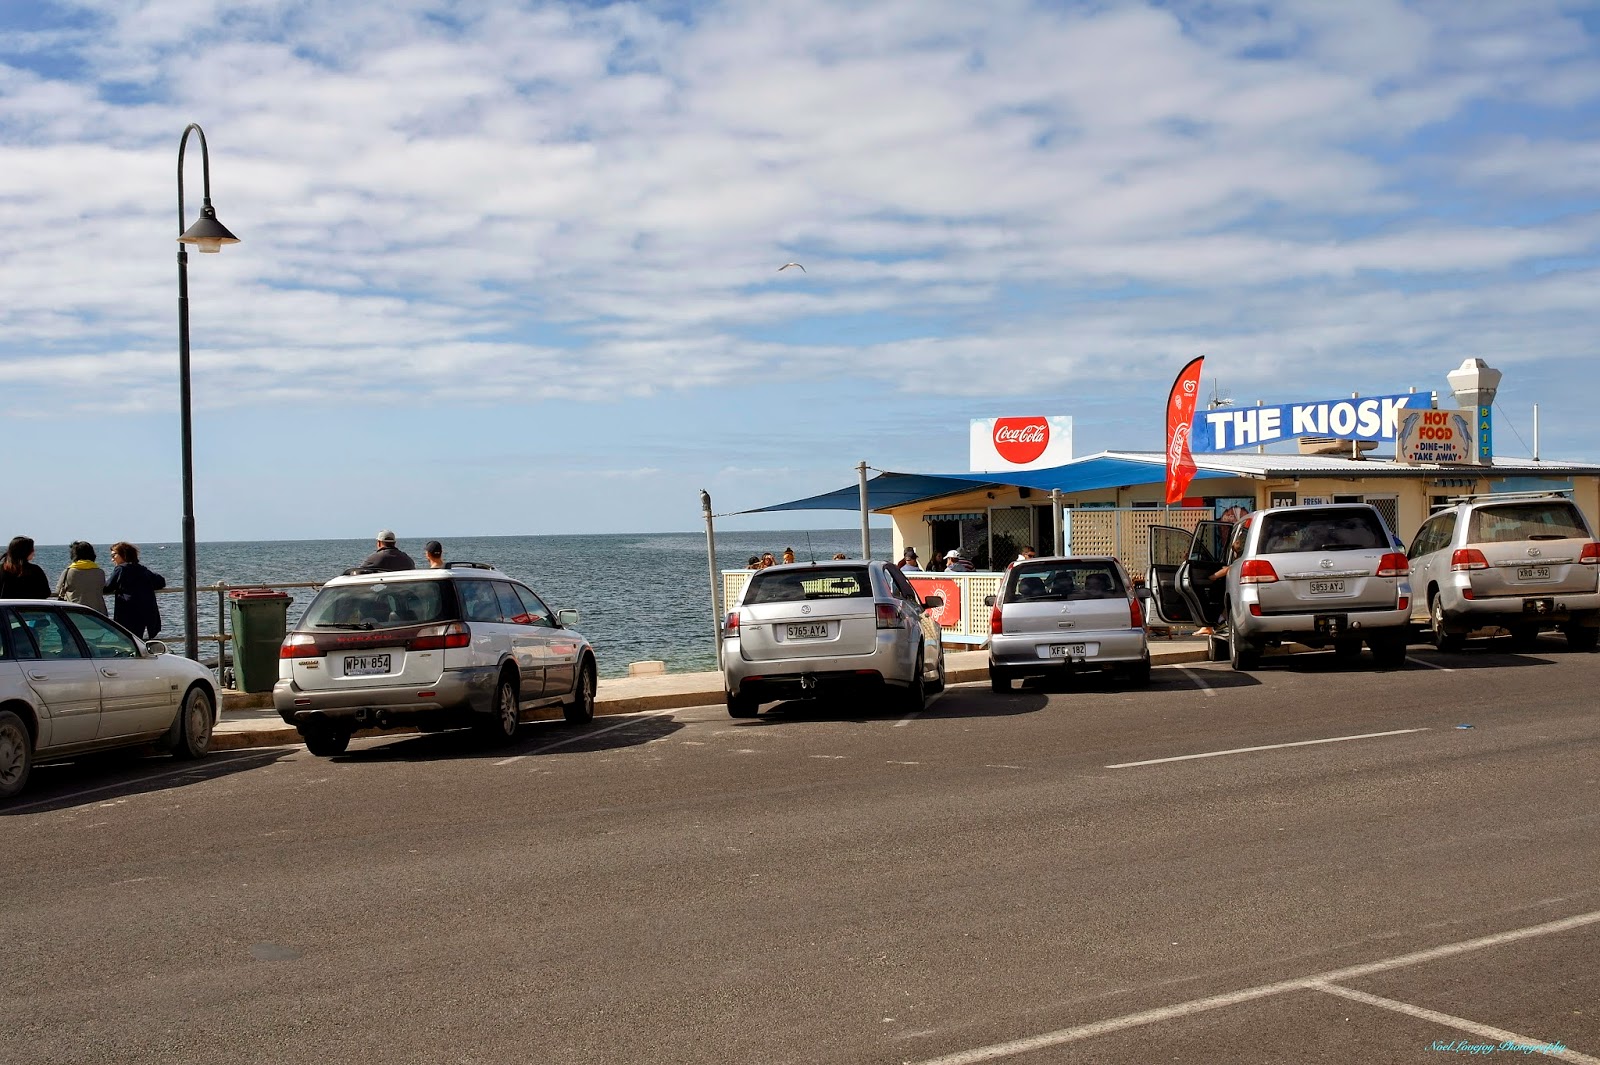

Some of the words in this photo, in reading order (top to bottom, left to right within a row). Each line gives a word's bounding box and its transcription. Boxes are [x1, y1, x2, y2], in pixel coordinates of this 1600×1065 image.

[1206, 408, 1281, 450] THE
[1292, 397, 1409, 439] KIOSK
[1424, 412, 1449, 425] HOT
[995, 424, 1048, 443] Coca-Cola
[1419, 427, 1453, 440] FOOD
[1481, 408, 1489, 455] BAIT
[1420, 442, 1452, 452] DINE-IN
[1413, 452, 1433, 461] TAKE
[1435, 453, 1458, 461] AWAY
[1273, 498, 1293, 507] EAT
[1303, 497, 1322, 506] FRESH
[1072, 645, 1085, 654] 182
[346, 658, 367, 670] WPN
[371, 656, 389, 668] 854
